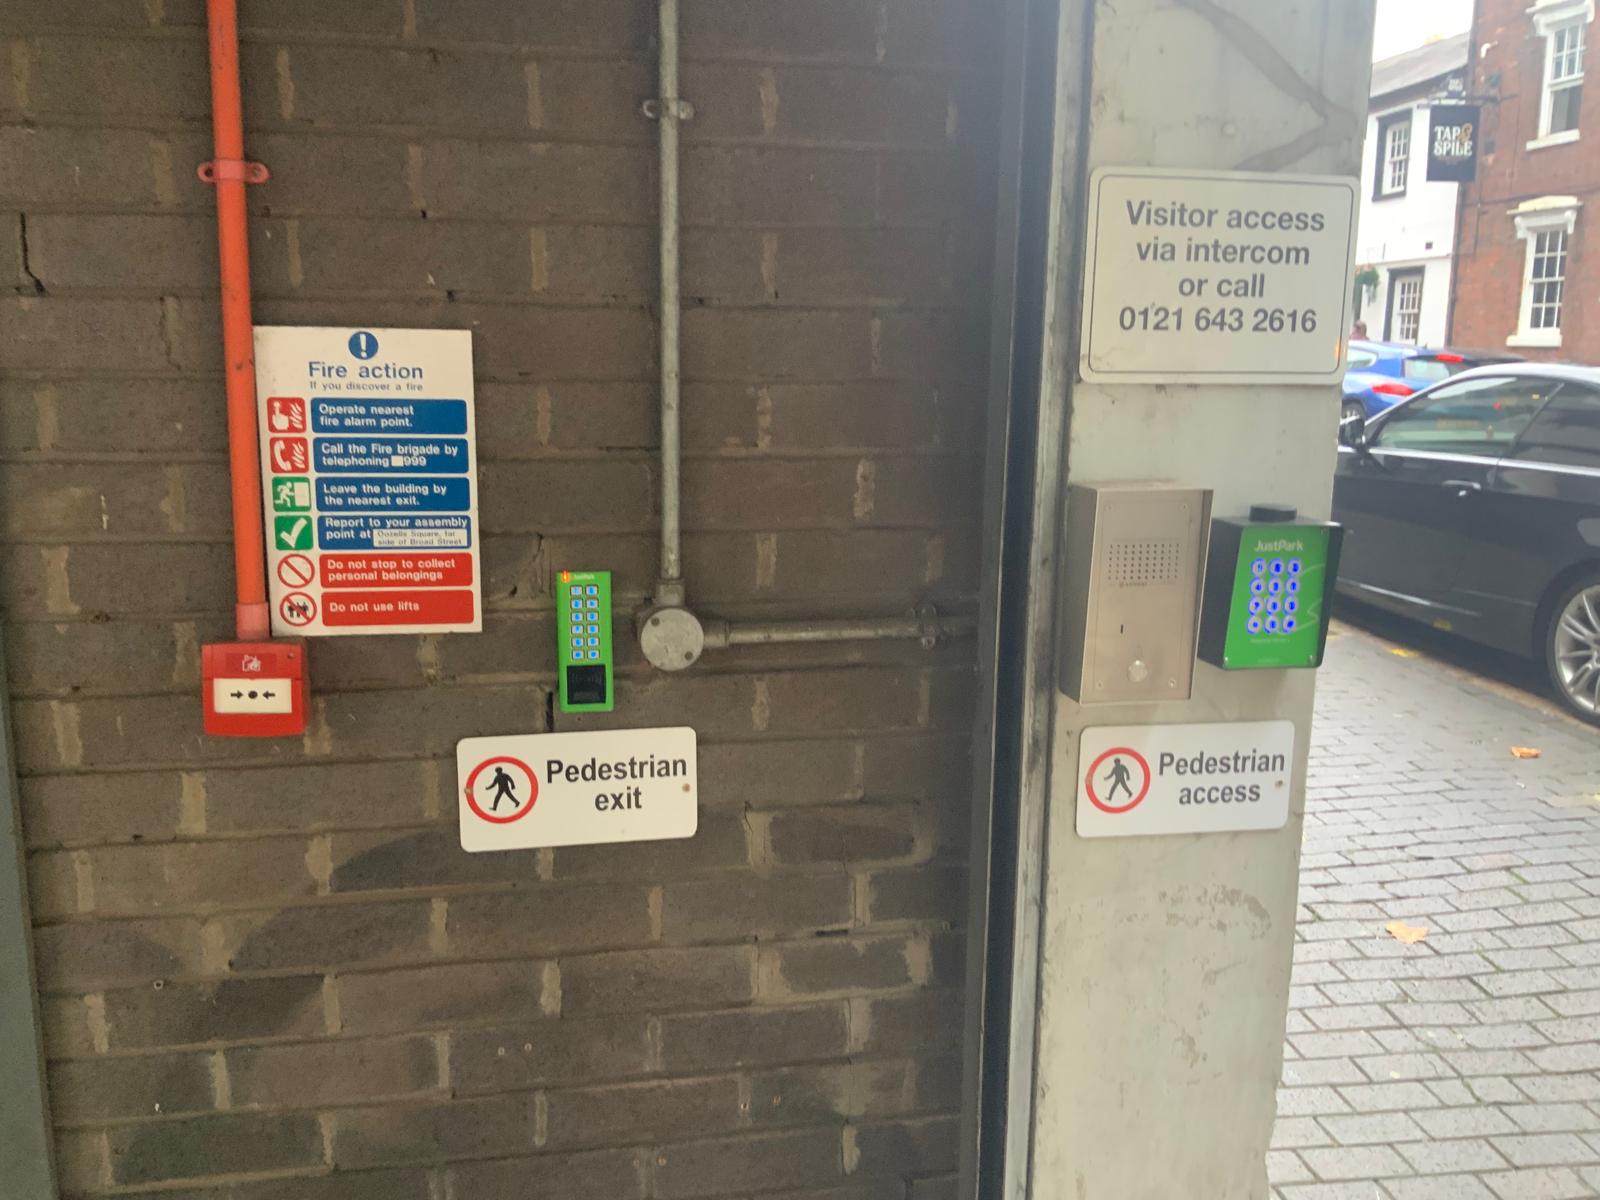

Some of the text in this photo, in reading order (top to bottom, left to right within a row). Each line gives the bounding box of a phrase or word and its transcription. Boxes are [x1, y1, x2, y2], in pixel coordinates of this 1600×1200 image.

[1434, 126, 1461, 140] TAP
[1433, 141, 1473, 156] SPILE
[1125, 199, 1325, 232] Visitor access
[1136, 236, 1310, 265] via intercom
[1178, 273, 1265, 298] or call
[1119, 306, 1317, 333] 0121 643 2616
[308, 361, 424, 379] Fire action
[322, 383, 342, 392] you
[346, 382, 390, 391] discover
[406, 382, 423, 391] fire
[319, 403, 414, 416] Operate nearest
[319, 416, 413, 428] fire alarm point.
[321, 443, 458, 456] Call the Fire brigade by
[322, 455, 427, 468] telephoning 999
[323, 484, 447, 496] Leave the building by
[324, 496, 420, 506] the nearest exit.
[325, 517, 468, 529] Report to your assembly
[326, 529, 371, 540] point at
[1254, 539, 1304, 552] JustPark
[327, 558, 456, 571] Do not stop to collect
[328, 570, 443, 582] personal belongings
[329, 601, 420, 612] Do not use lifts
[1158, 747, 1285, 776] Pedestrian
[546, 753, 687, 784] Pedestrian
[594, 786, 643, 811] exit
[1178, 783, 1261, 805] access
